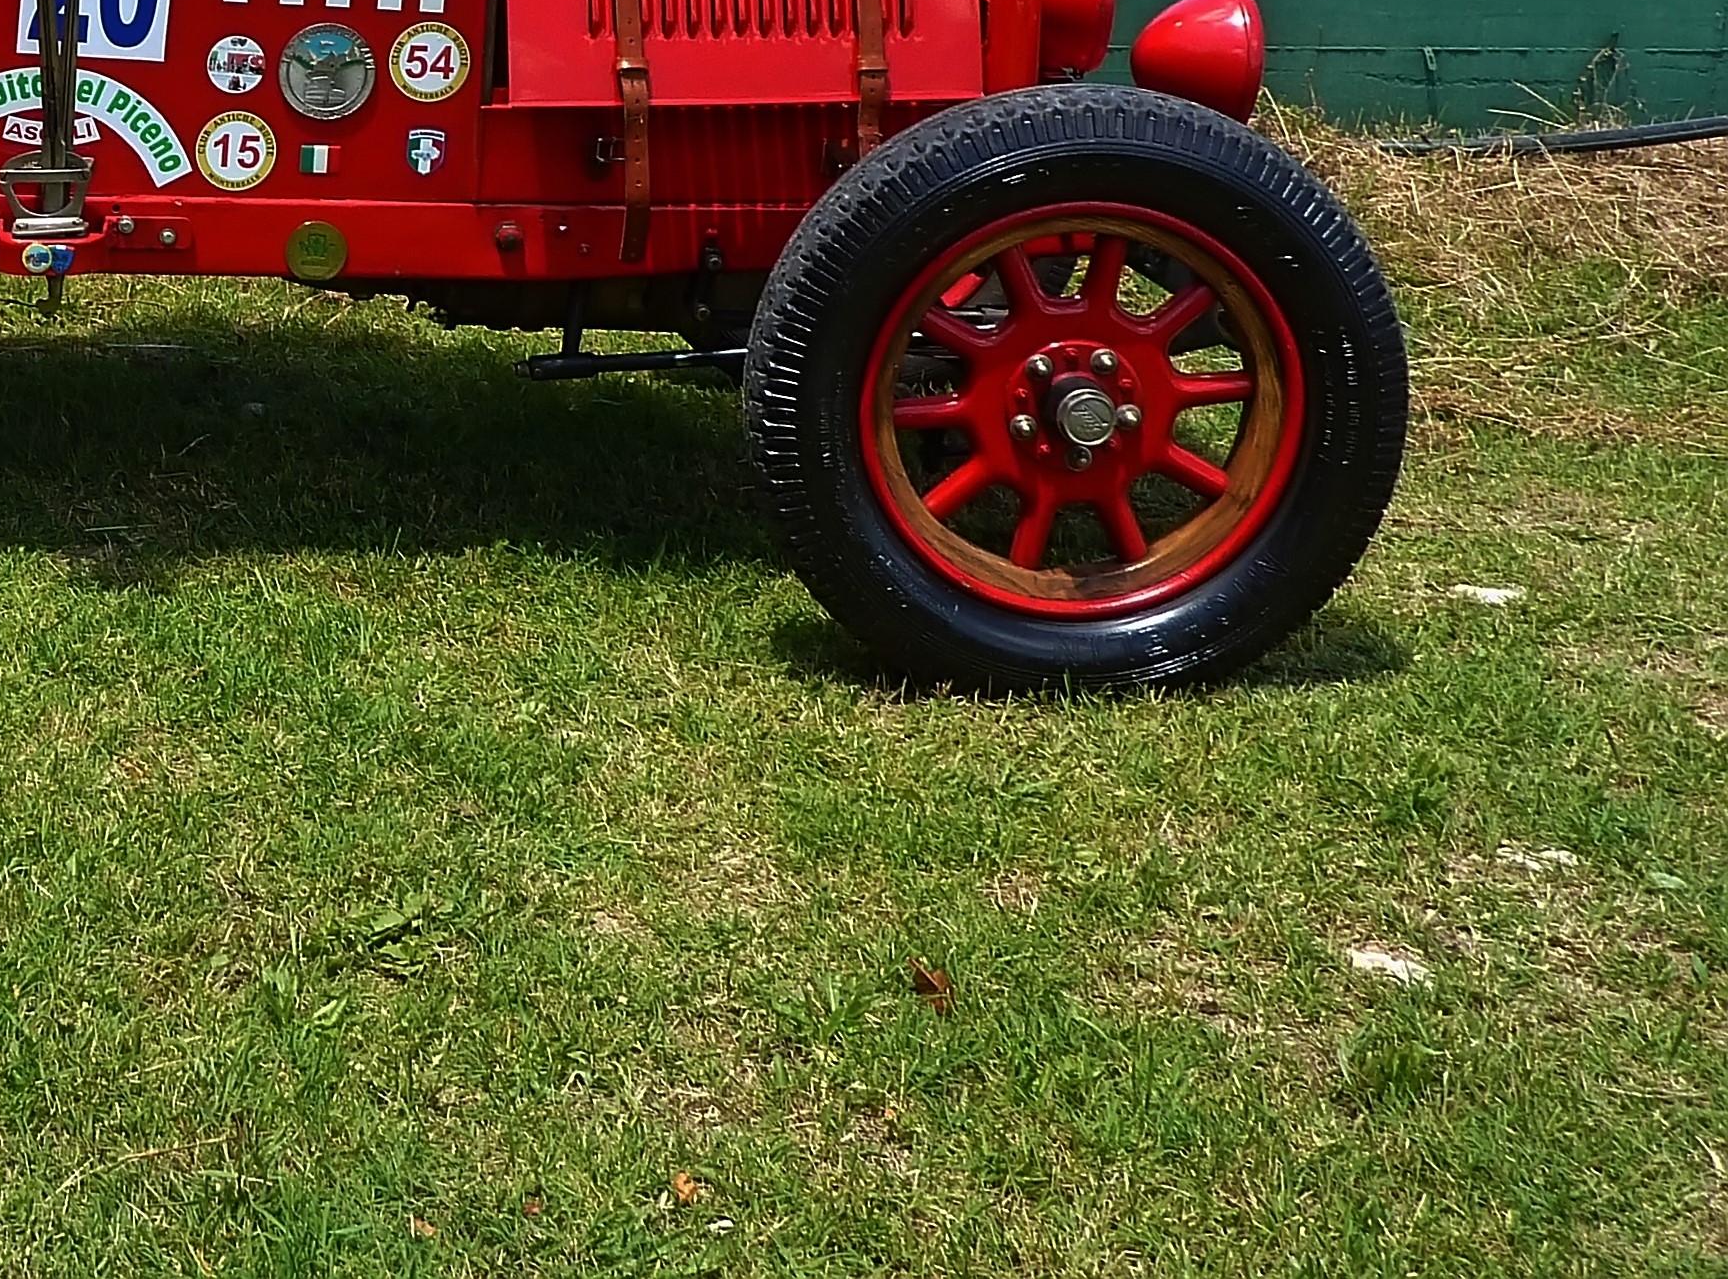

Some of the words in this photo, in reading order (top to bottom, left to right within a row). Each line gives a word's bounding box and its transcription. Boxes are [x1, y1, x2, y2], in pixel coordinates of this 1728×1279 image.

[405, 45, 455, 80] 54
[5, 121, 94, 141] ASLI
[76, 78, 107, 107] el
[106, 88, 183, 174] Piceno
[213, 133, 261, 169] 15
